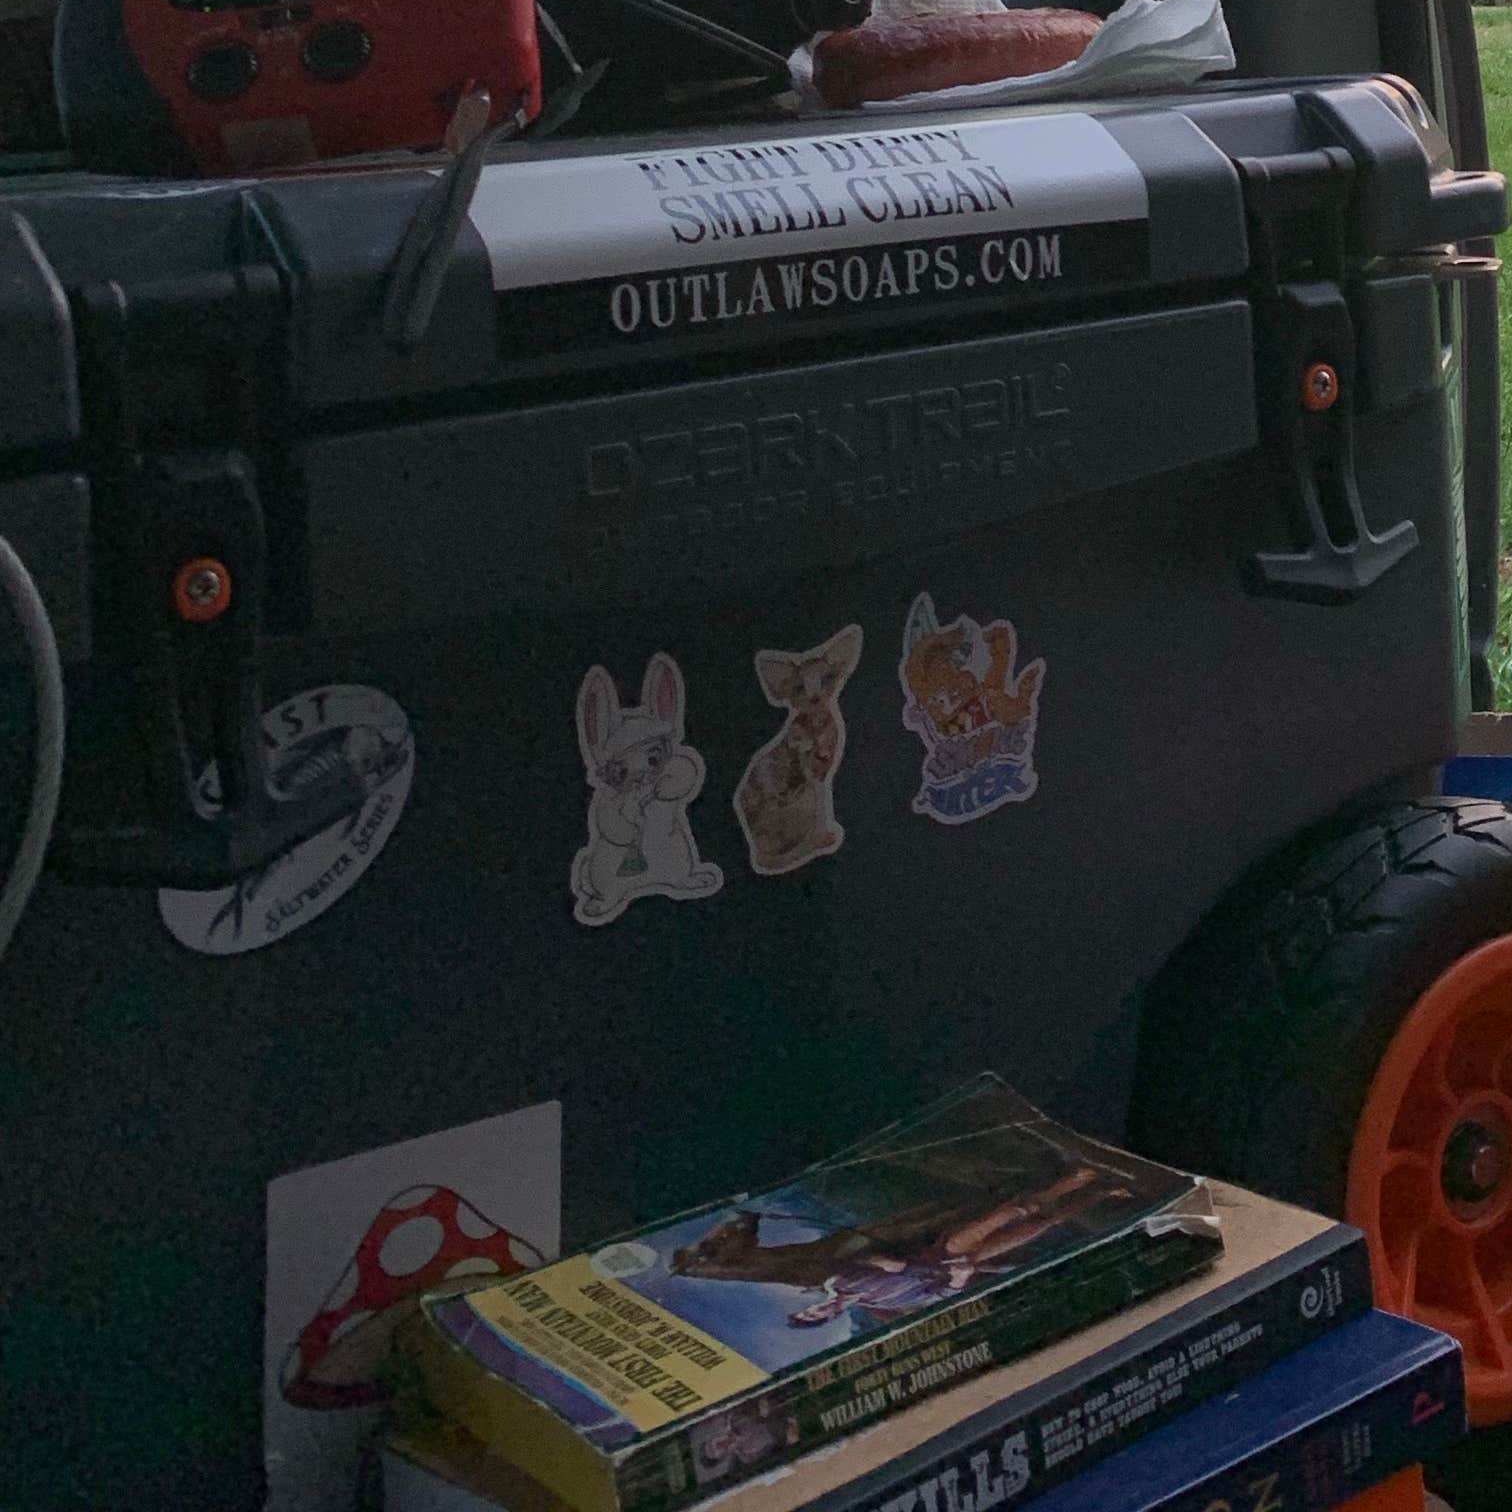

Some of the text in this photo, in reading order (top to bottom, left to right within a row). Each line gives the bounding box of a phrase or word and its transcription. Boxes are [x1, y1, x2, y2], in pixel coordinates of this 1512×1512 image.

[630, 128, 980, 191] FIGHT DIRTY
[660, 166, 1016, 244] SMELL CLEAN
[610, 233, 1064, 334] OUTLAWSOAPS.COM
[608, 1349, 670, 1390] FIRST
[651, 1379, 701, 1412] THE
[821, 1340, 993, 1432] WILLIAM W. JOHNSTONE
